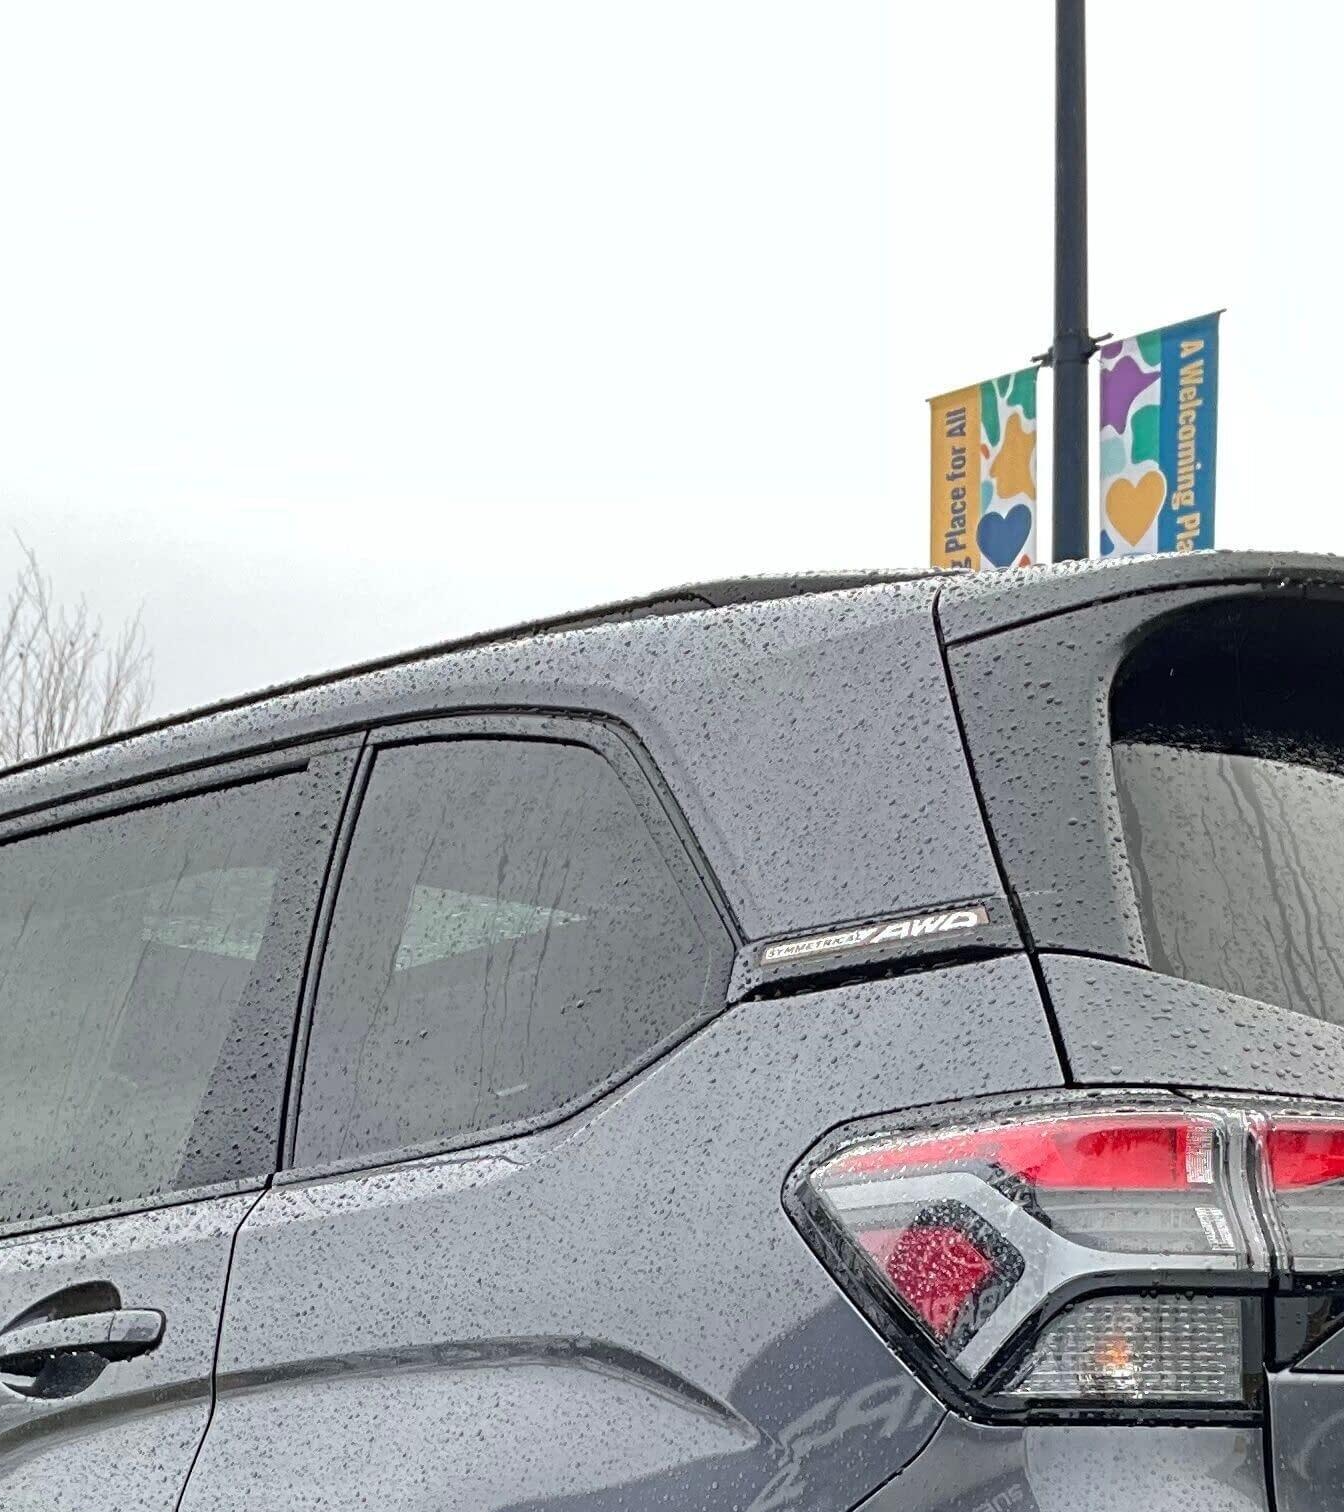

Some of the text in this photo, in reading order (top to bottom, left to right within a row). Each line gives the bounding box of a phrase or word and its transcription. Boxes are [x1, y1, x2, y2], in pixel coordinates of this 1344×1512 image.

[1180, 340, 1205, 358] A
[945, 406, 967, 438] All
[1171, 360, 1205, 510] Welcoming
[945, 446, 967, 482] for
[944, 487, 967, 553] Place
[767, 911, 978, 959] SYMMETRICAL AWD
